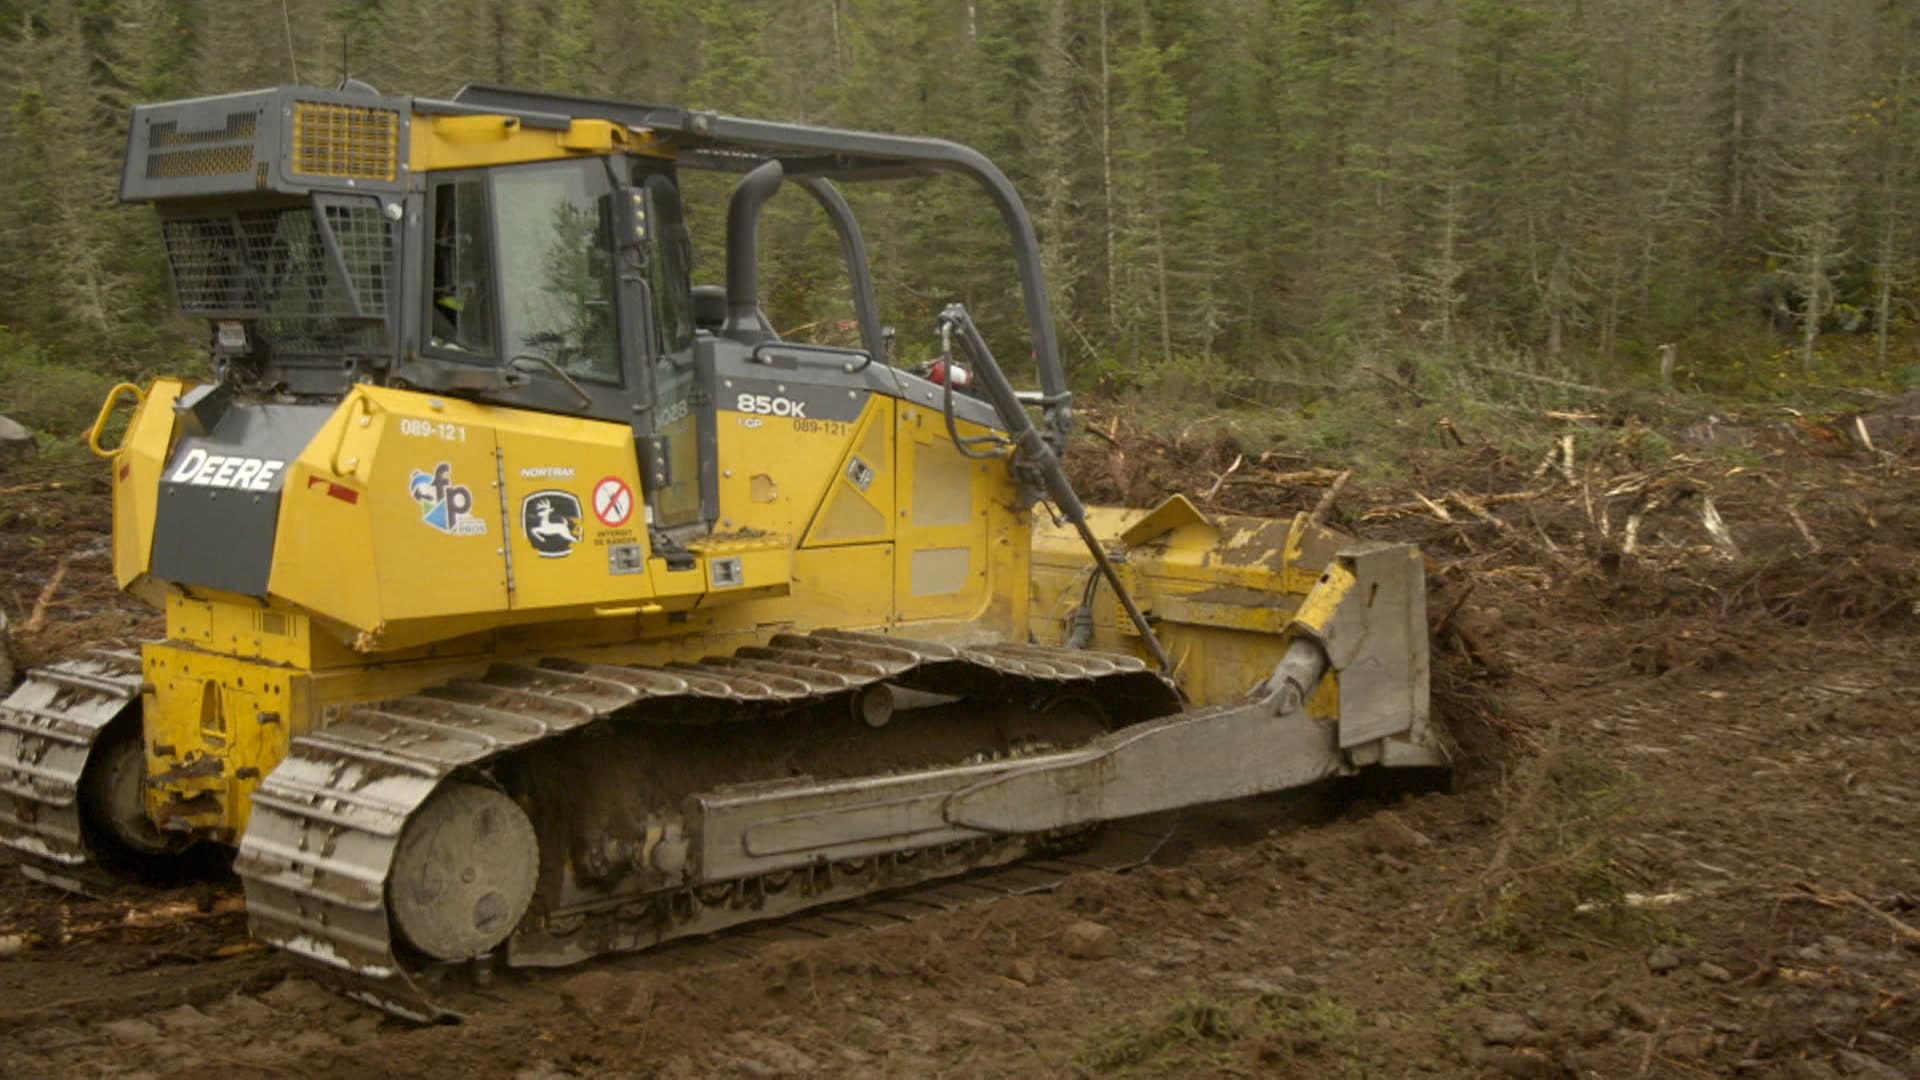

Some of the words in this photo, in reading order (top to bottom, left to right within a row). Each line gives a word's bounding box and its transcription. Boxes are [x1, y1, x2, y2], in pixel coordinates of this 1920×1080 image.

[737, 393, 806, 418] 850K
[401, 418, 465, 442] 089-121
[793, 420, 846, 437] 089-121
